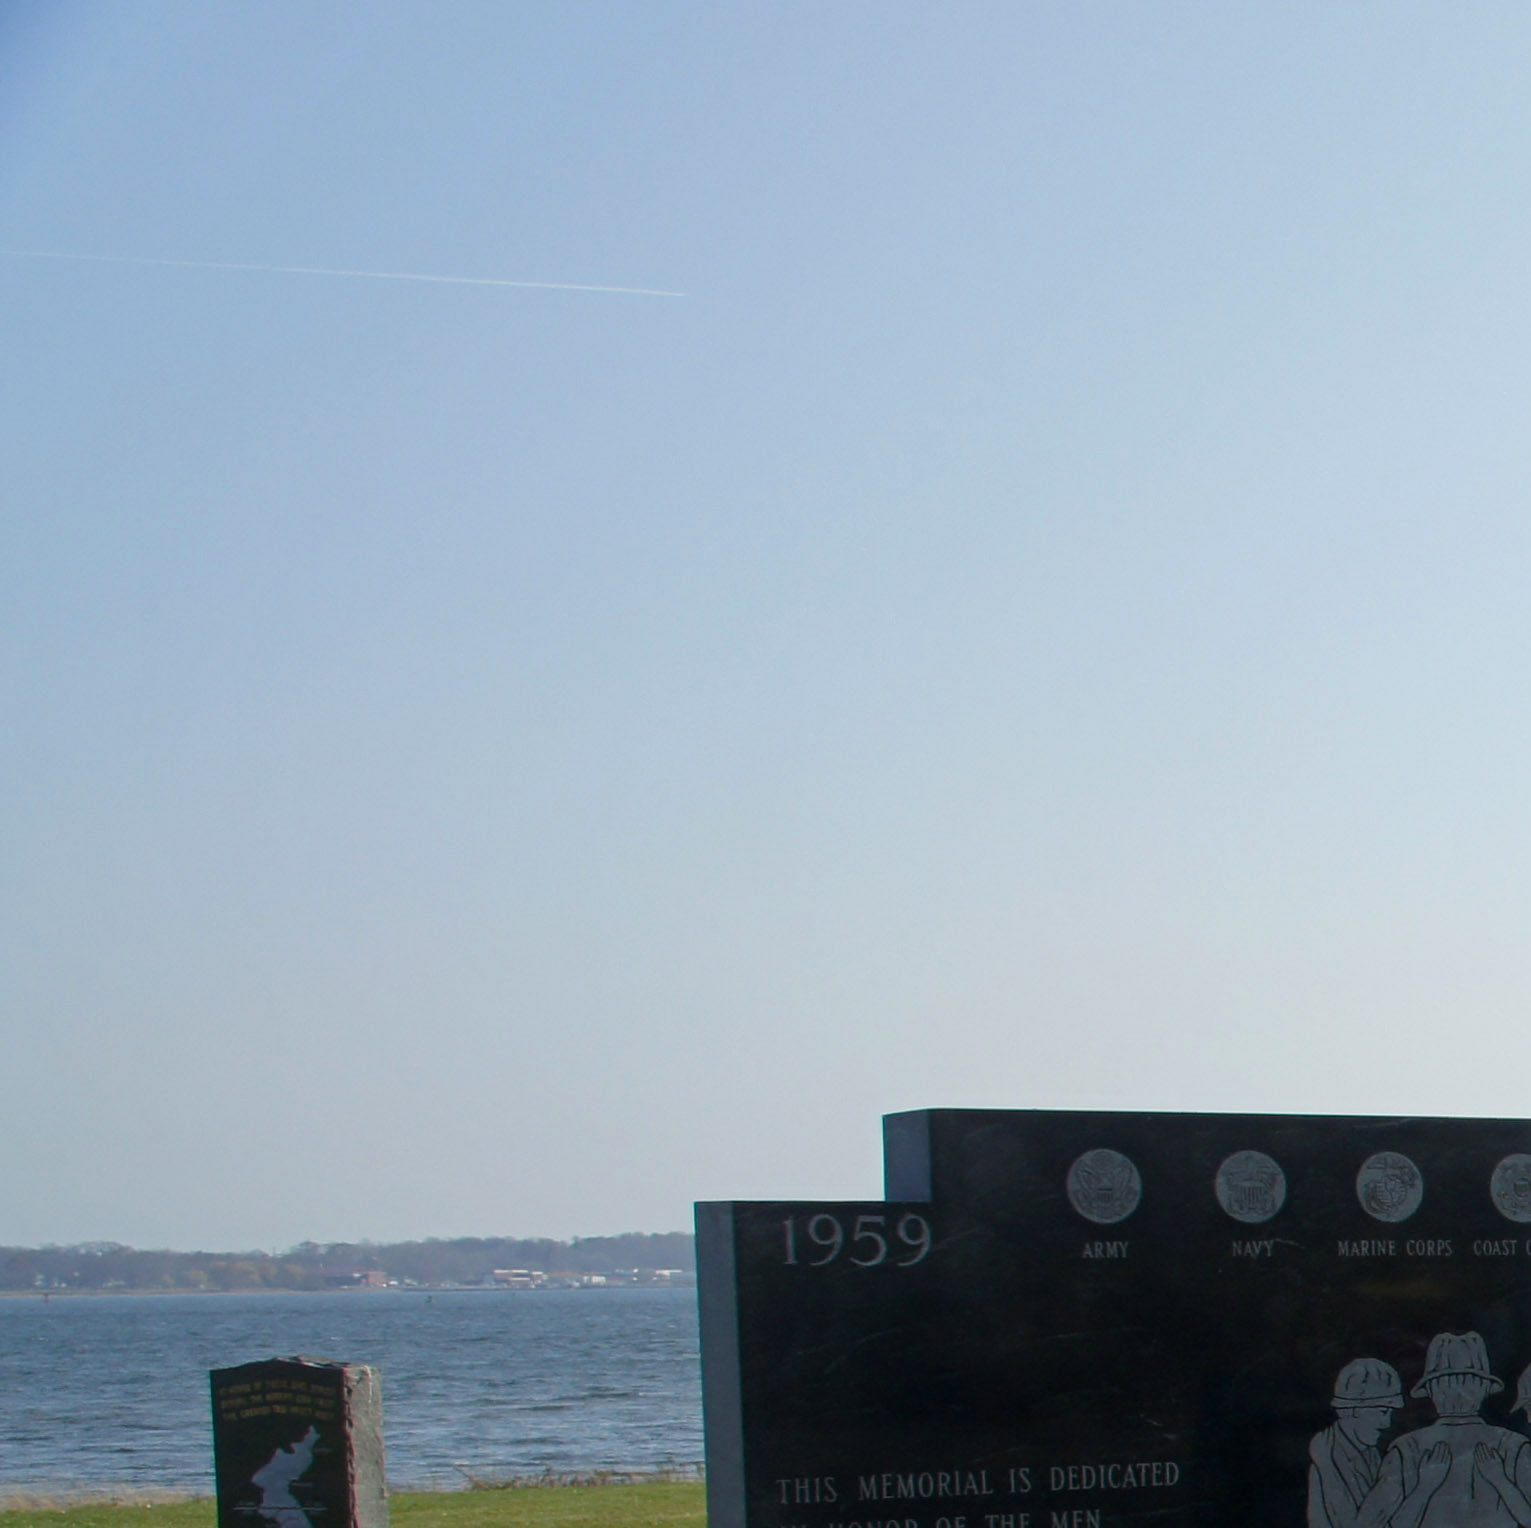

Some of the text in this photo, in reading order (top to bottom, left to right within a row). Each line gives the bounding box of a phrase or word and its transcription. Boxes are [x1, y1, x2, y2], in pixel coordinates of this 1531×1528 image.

[783, 1214, 930, 1267] 1959
[1082, 1241, 1128, 1258] ARMY
[1232, 1239, 1274, 1259] NAVY
[1338, 1239, 1453, 1256] MARINE CORPS
[1473, 1240, 1517, 1256] COAST
[776, 1462, 1179, 1504] THIS MEMORIAL IS DEDICATED
